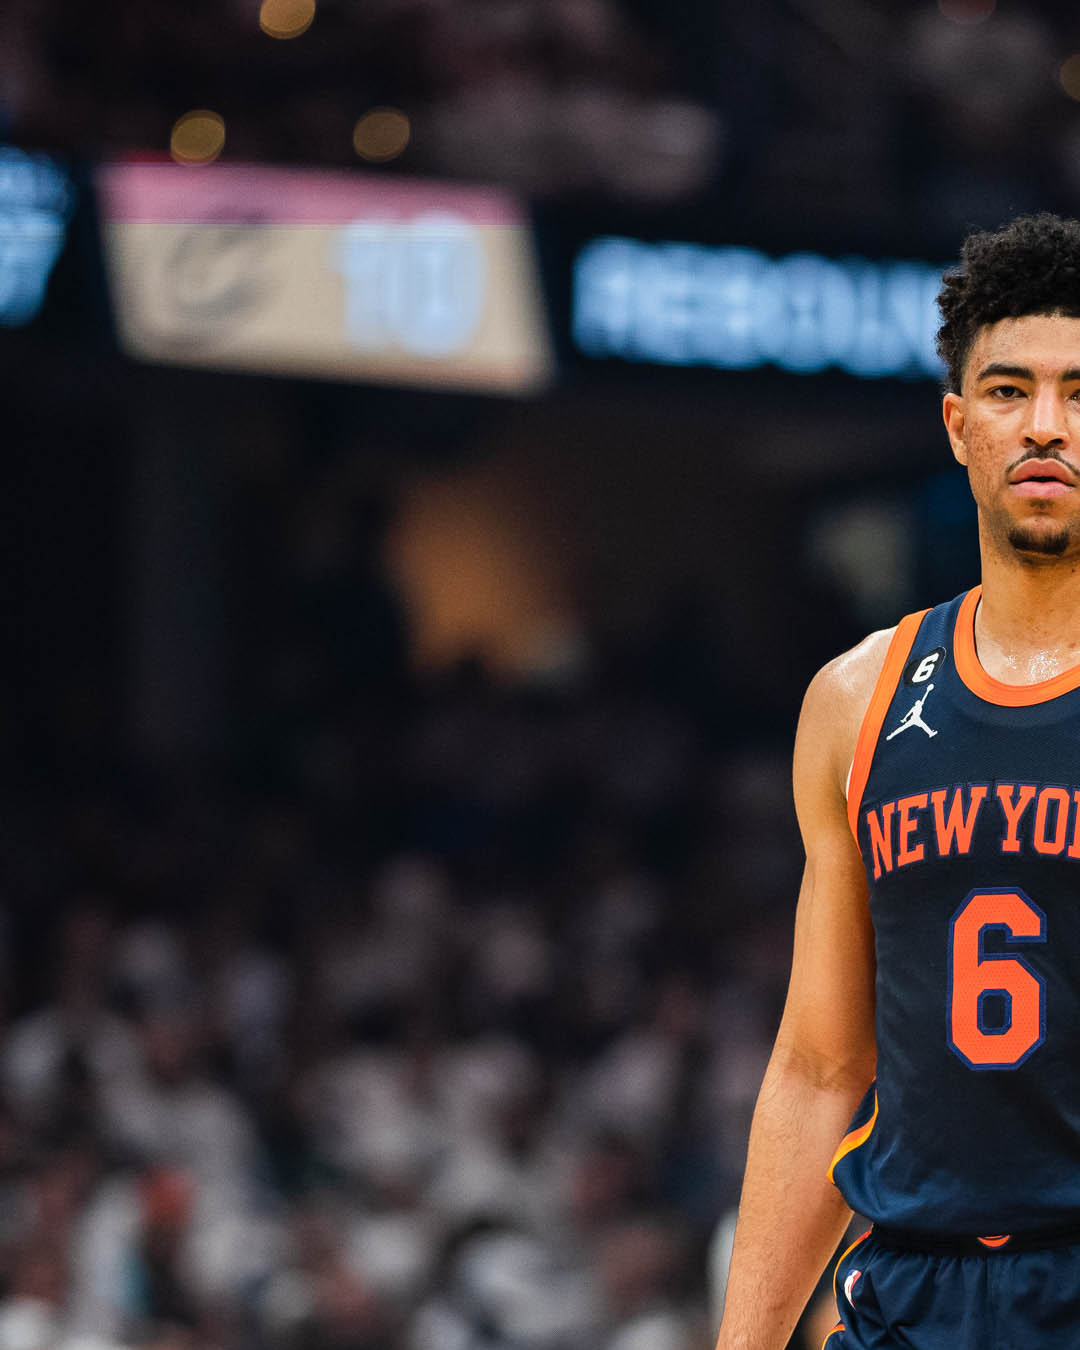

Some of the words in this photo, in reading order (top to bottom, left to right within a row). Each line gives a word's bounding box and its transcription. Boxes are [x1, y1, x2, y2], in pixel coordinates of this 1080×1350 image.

[911, 652, 940, 683] 6
[865, 784, 990, 881] NEW
[947, 887, 1047, 1071] 6
